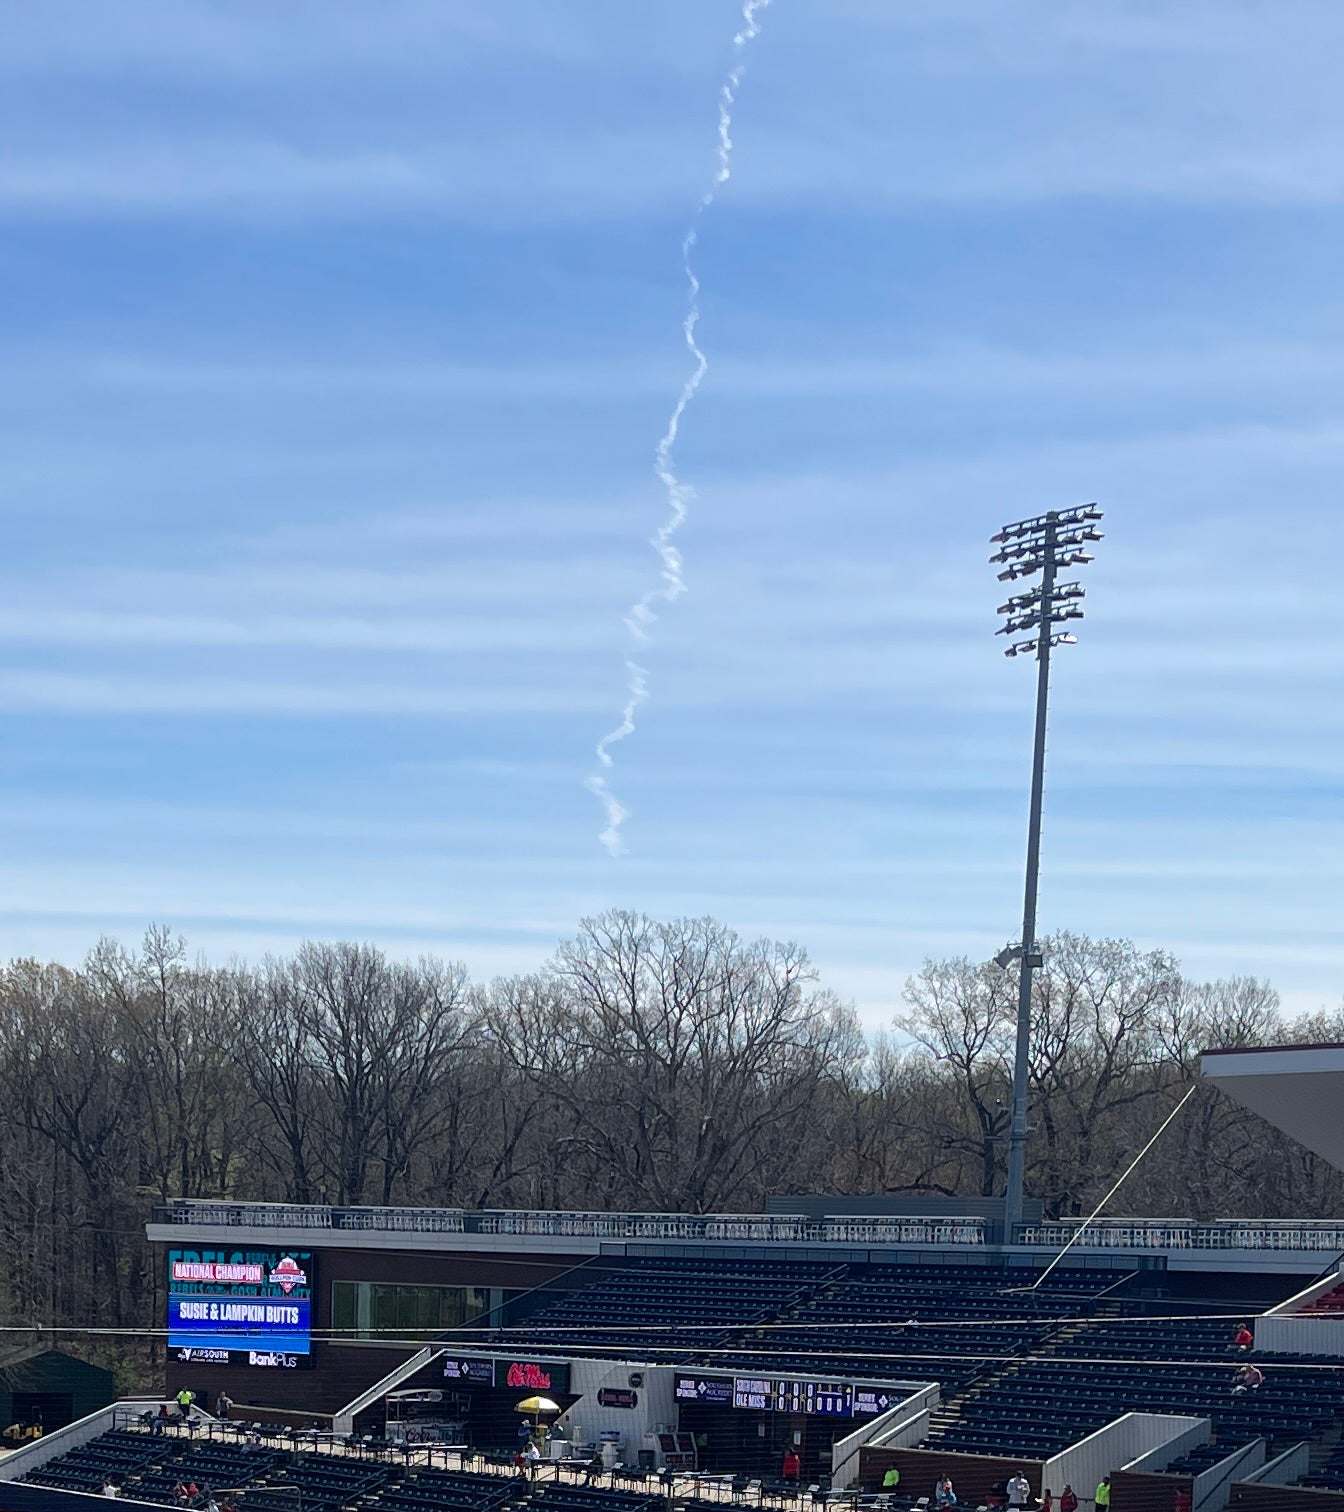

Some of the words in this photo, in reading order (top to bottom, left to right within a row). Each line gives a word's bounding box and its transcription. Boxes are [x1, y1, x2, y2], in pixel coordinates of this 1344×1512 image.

[175, 1263, 214, 1279] NATIONAL
[216, 1265, 261, 1281] CHAMPION
[180, 1302, 209, 1319] SUSIE
[210, 1304, 218, 1320] &
[220, 1304, 264, 1322] LAMPKIN
[266, 1305, 299, 1324] BUTTS
[249, 1351, 297, 1367] BankPlus
